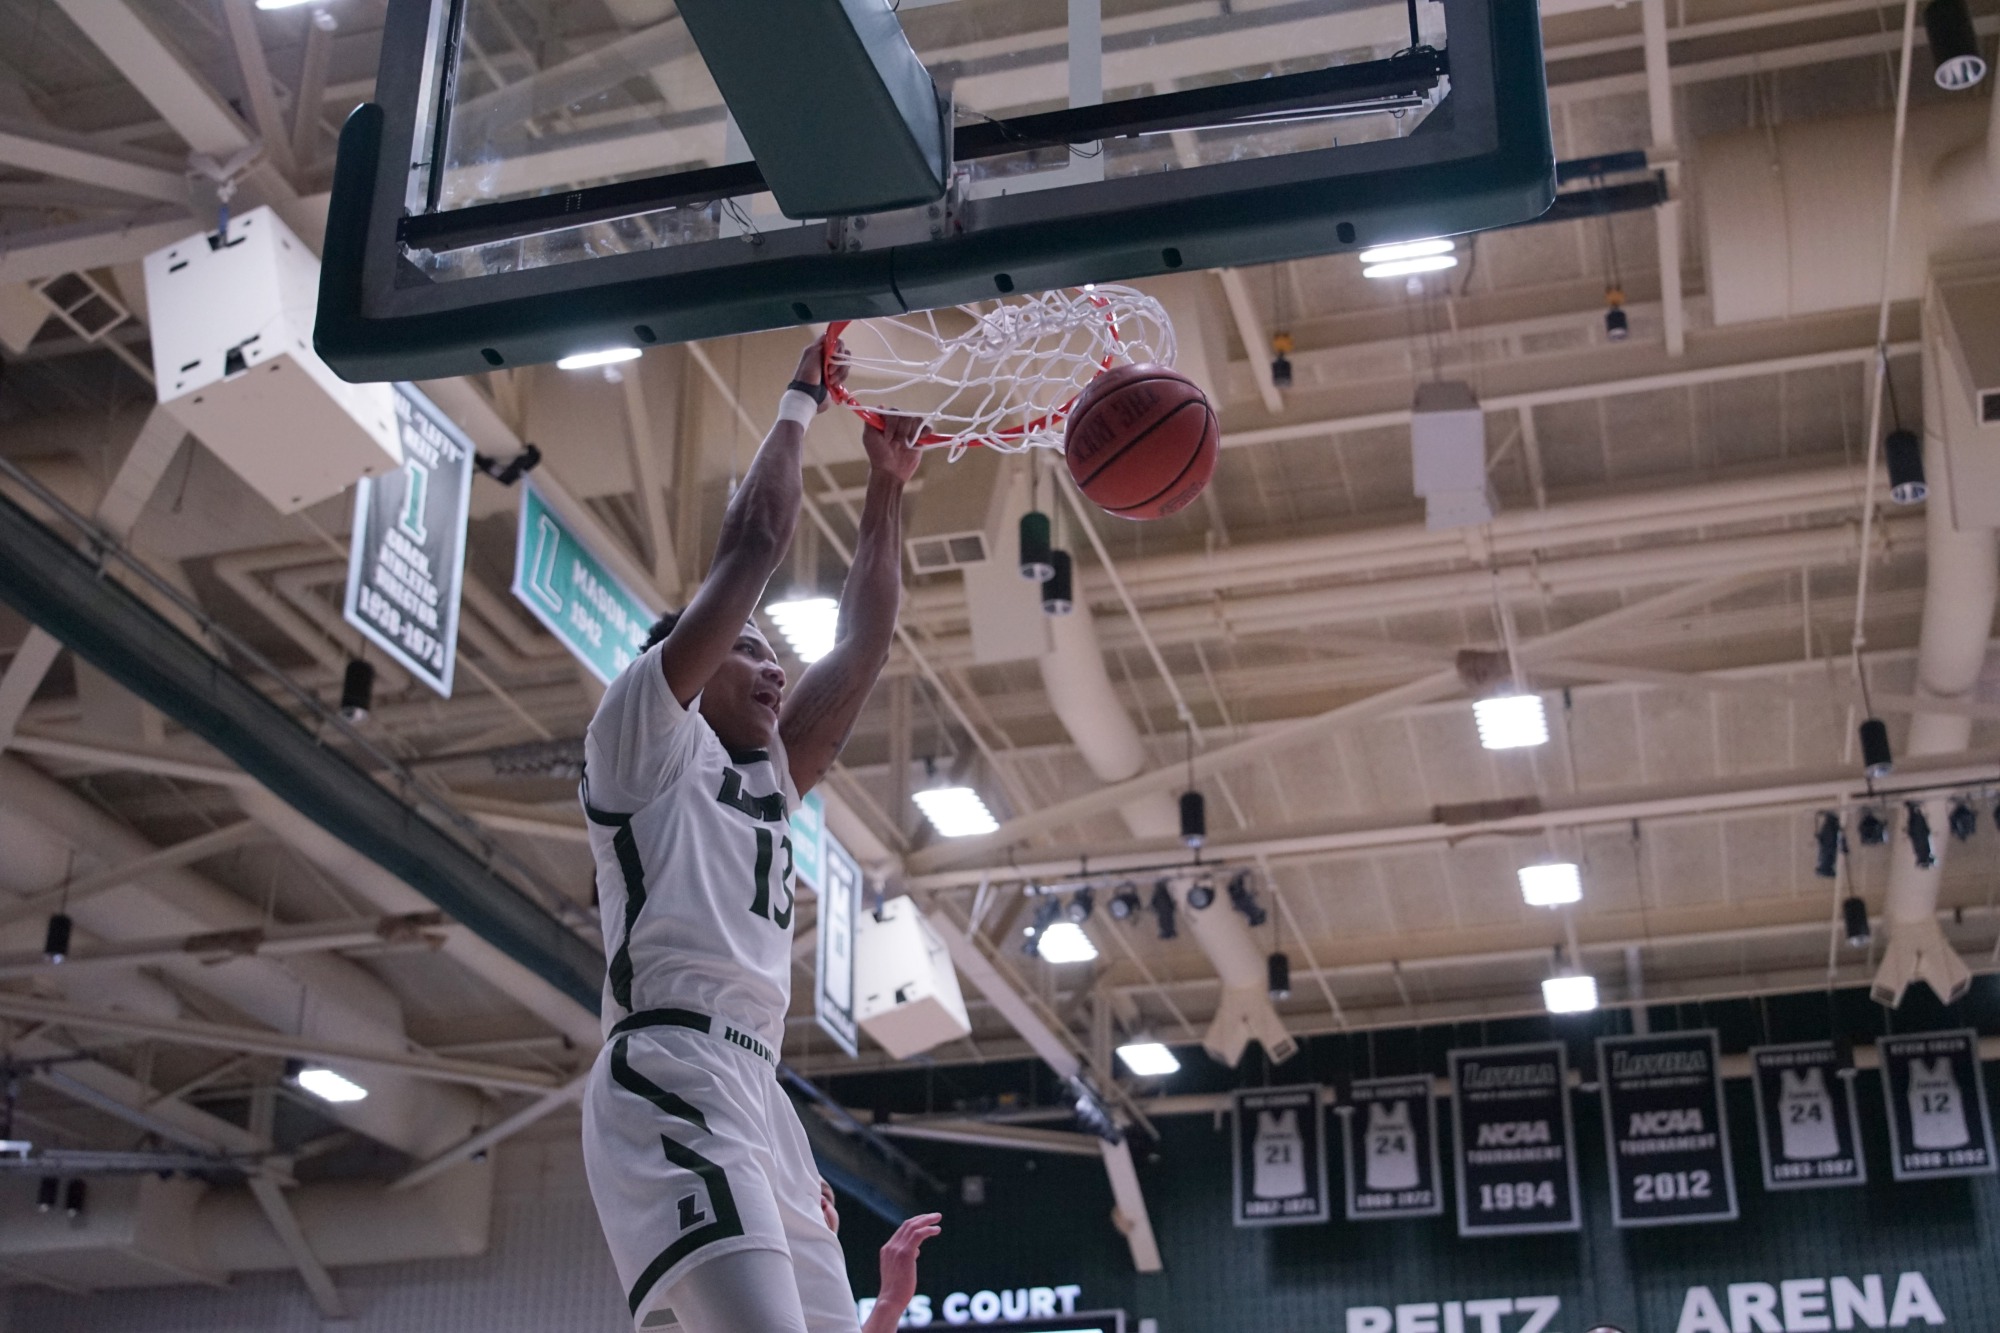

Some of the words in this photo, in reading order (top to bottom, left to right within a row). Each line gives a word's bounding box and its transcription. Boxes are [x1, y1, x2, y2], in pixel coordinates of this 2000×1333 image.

[400, 457, 428, 546] 1
[749, 825, 795, 930] 13
[1789, 1102, 1823, 1124] 24
[1920, 1091, 1951, 1114] 12
[1477, 1120, 1550, 1147] NCAA
[1629, 1108, 1704, 1137] NCAA
[1264, 1144, 1292, 1165] 21
[1375, 1134, 1407, 1156] 24
[1468, 1145, 1562, 1165] TOURNAMENT
[1619, 1133, 1717, 1155] TOURNAMENT
[1480, 1180, 1556, 1211] 1994
[1633, 1169, 1712, 1203] 2012
[677, 1193, 706, 1231] L
[943, 1285, 1081, 1324] COURT
[1676, 1271, 1947, 1333] ARENA
